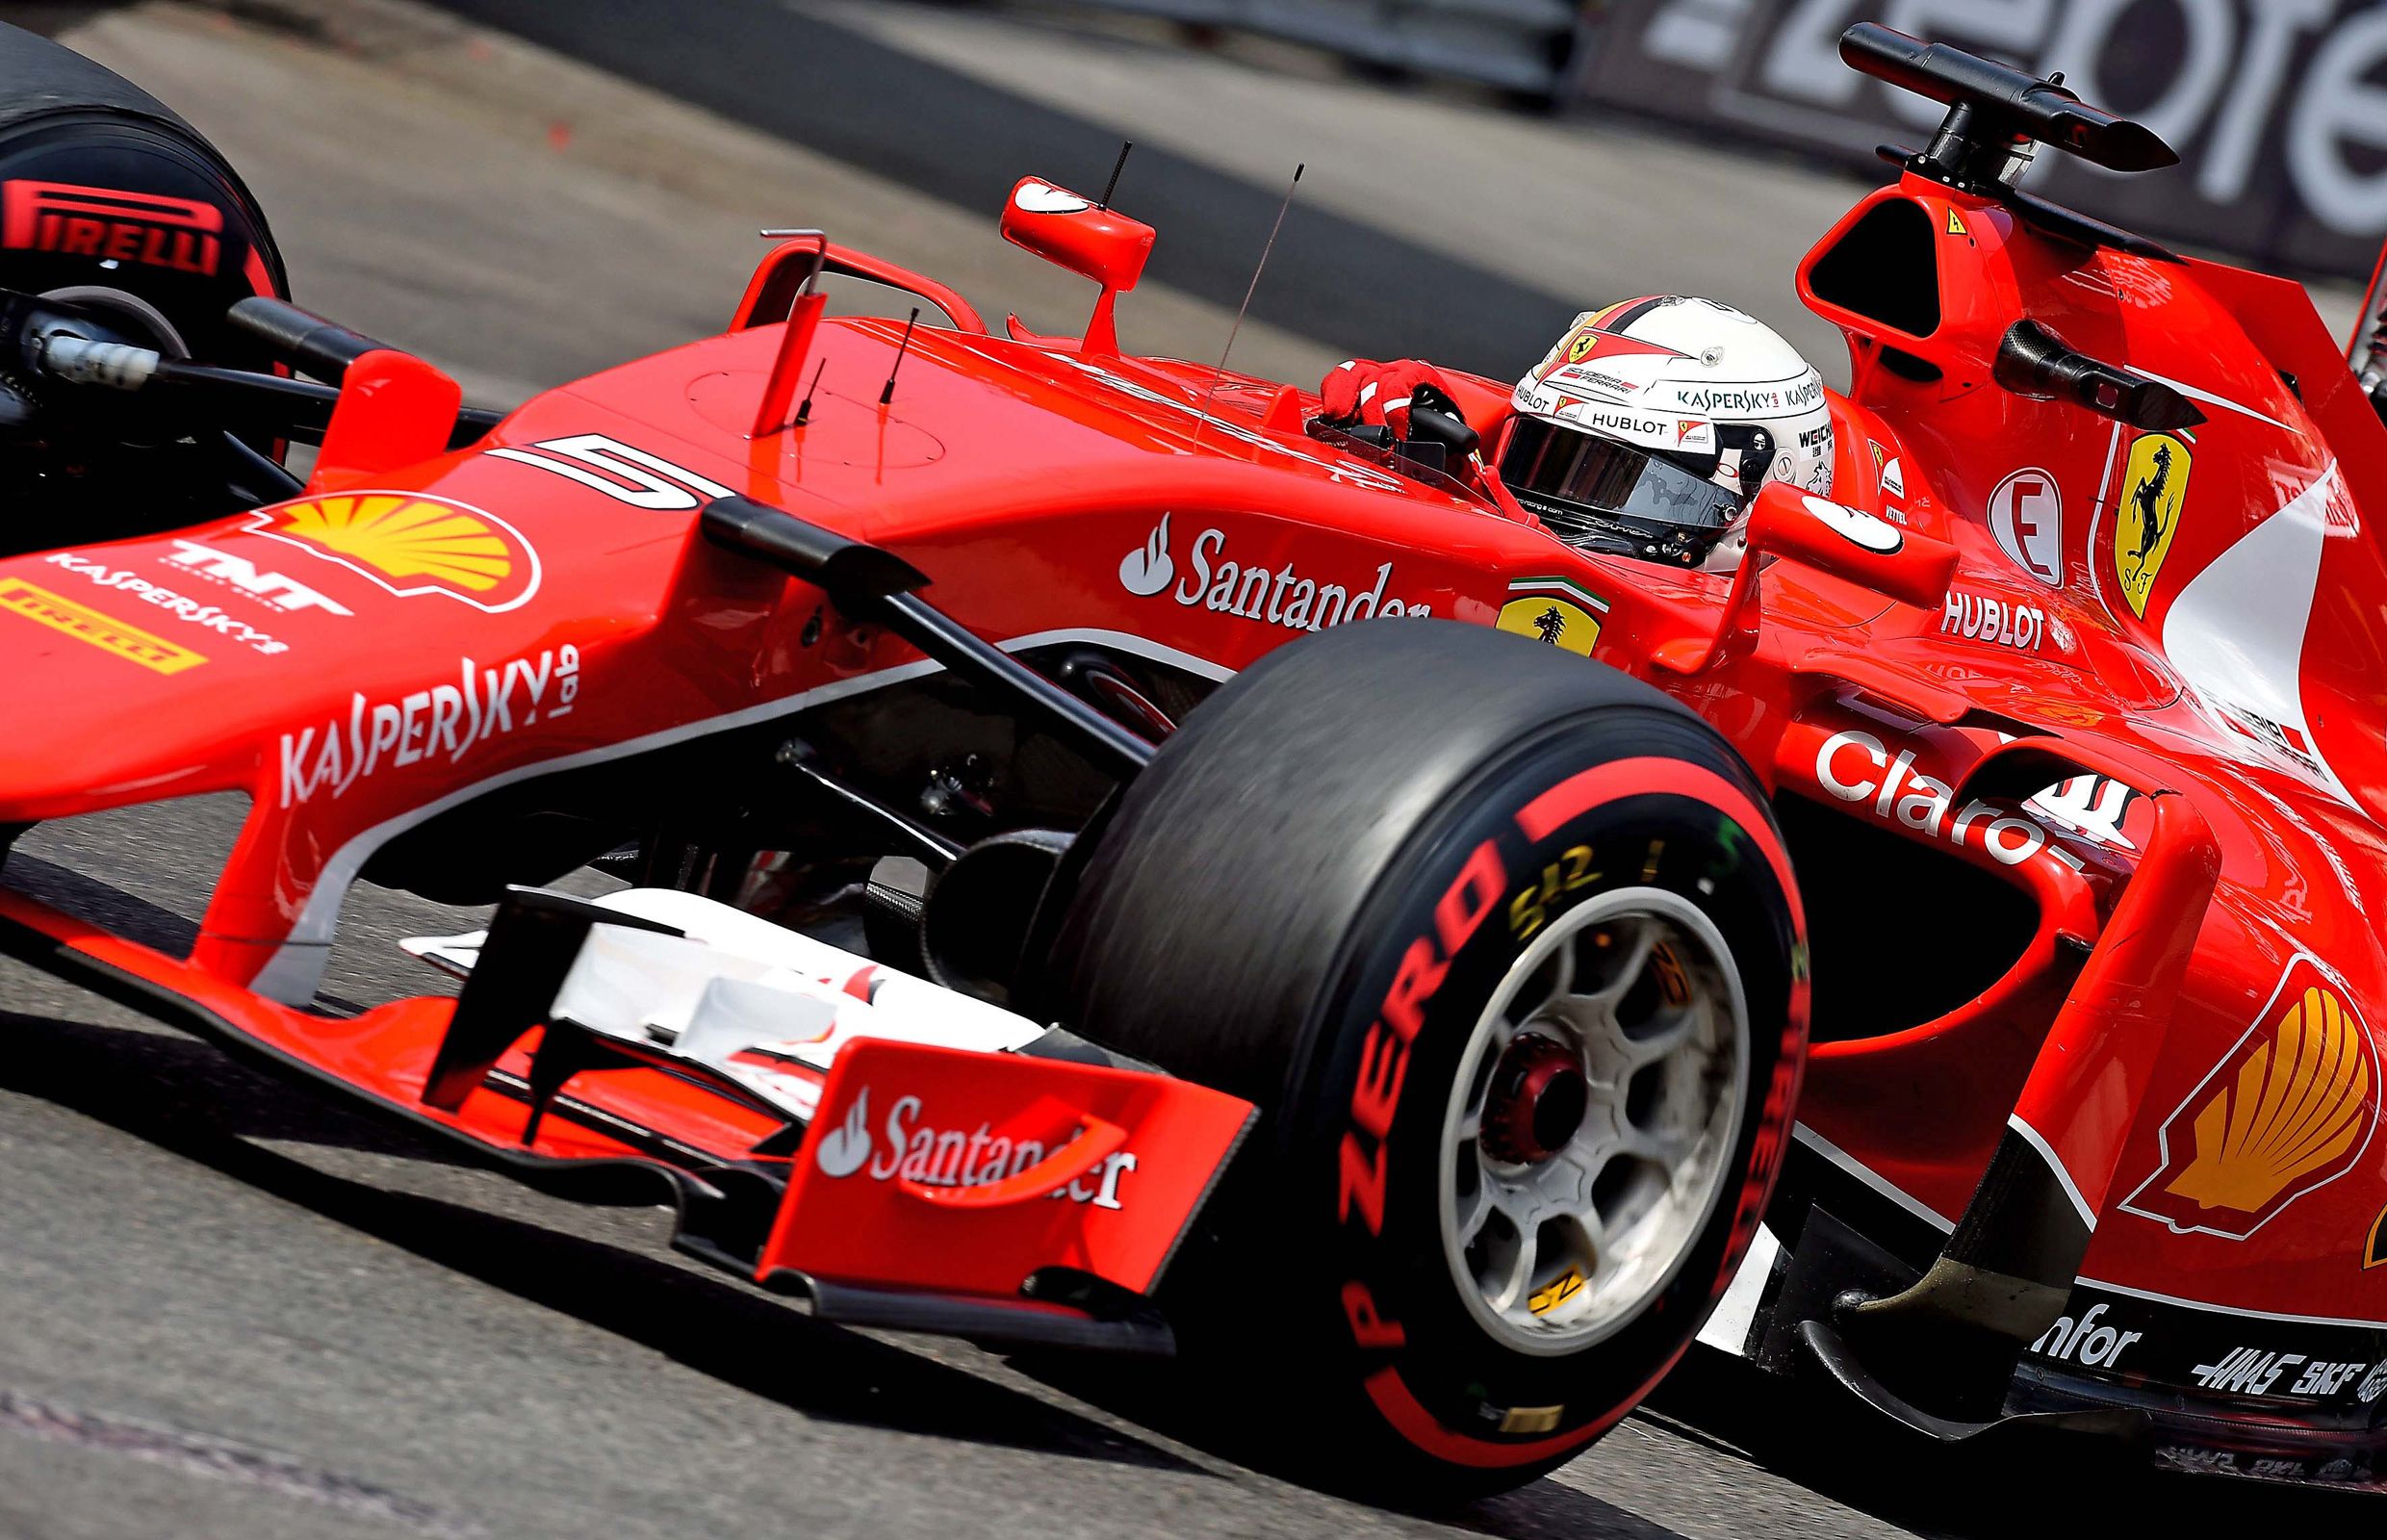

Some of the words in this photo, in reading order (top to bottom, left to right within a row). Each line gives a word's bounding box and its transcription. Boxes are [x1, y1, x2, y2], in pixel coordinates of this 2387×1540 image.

[2, 179, 224, 277] PIRELLI
[1516, 385, 1550, 412] HUBLOT
[1566, 367, 1623, 384] SCUDERIA
[1579, 375, 1631, 394] FERRARI
[1678, 389, 1770, 412] KASPERSKY
[1592, 413, 1667, 436] HUBLOT
[481, 432, 738, 511] 5
[1886, 504, 1908, 526] VETTEL
[44, 552, 273, 643] KASPERSKY
[167, 538, 355, 616] TNT
[1941, 591, 2045, 652] HUBLOT
[280, 650, 554, 809] KASPERSKY
[548, 643, 580, 720] lab
[1338, 837, 1508, 1238] ZERO
[1341, 1280, 1407, 1348] P
[2029, 1303, 2143, 1368] nfor
[2191, 1347, 2308, 1396] HAAS
[2290, 1360, 2367, 1396] SKF
